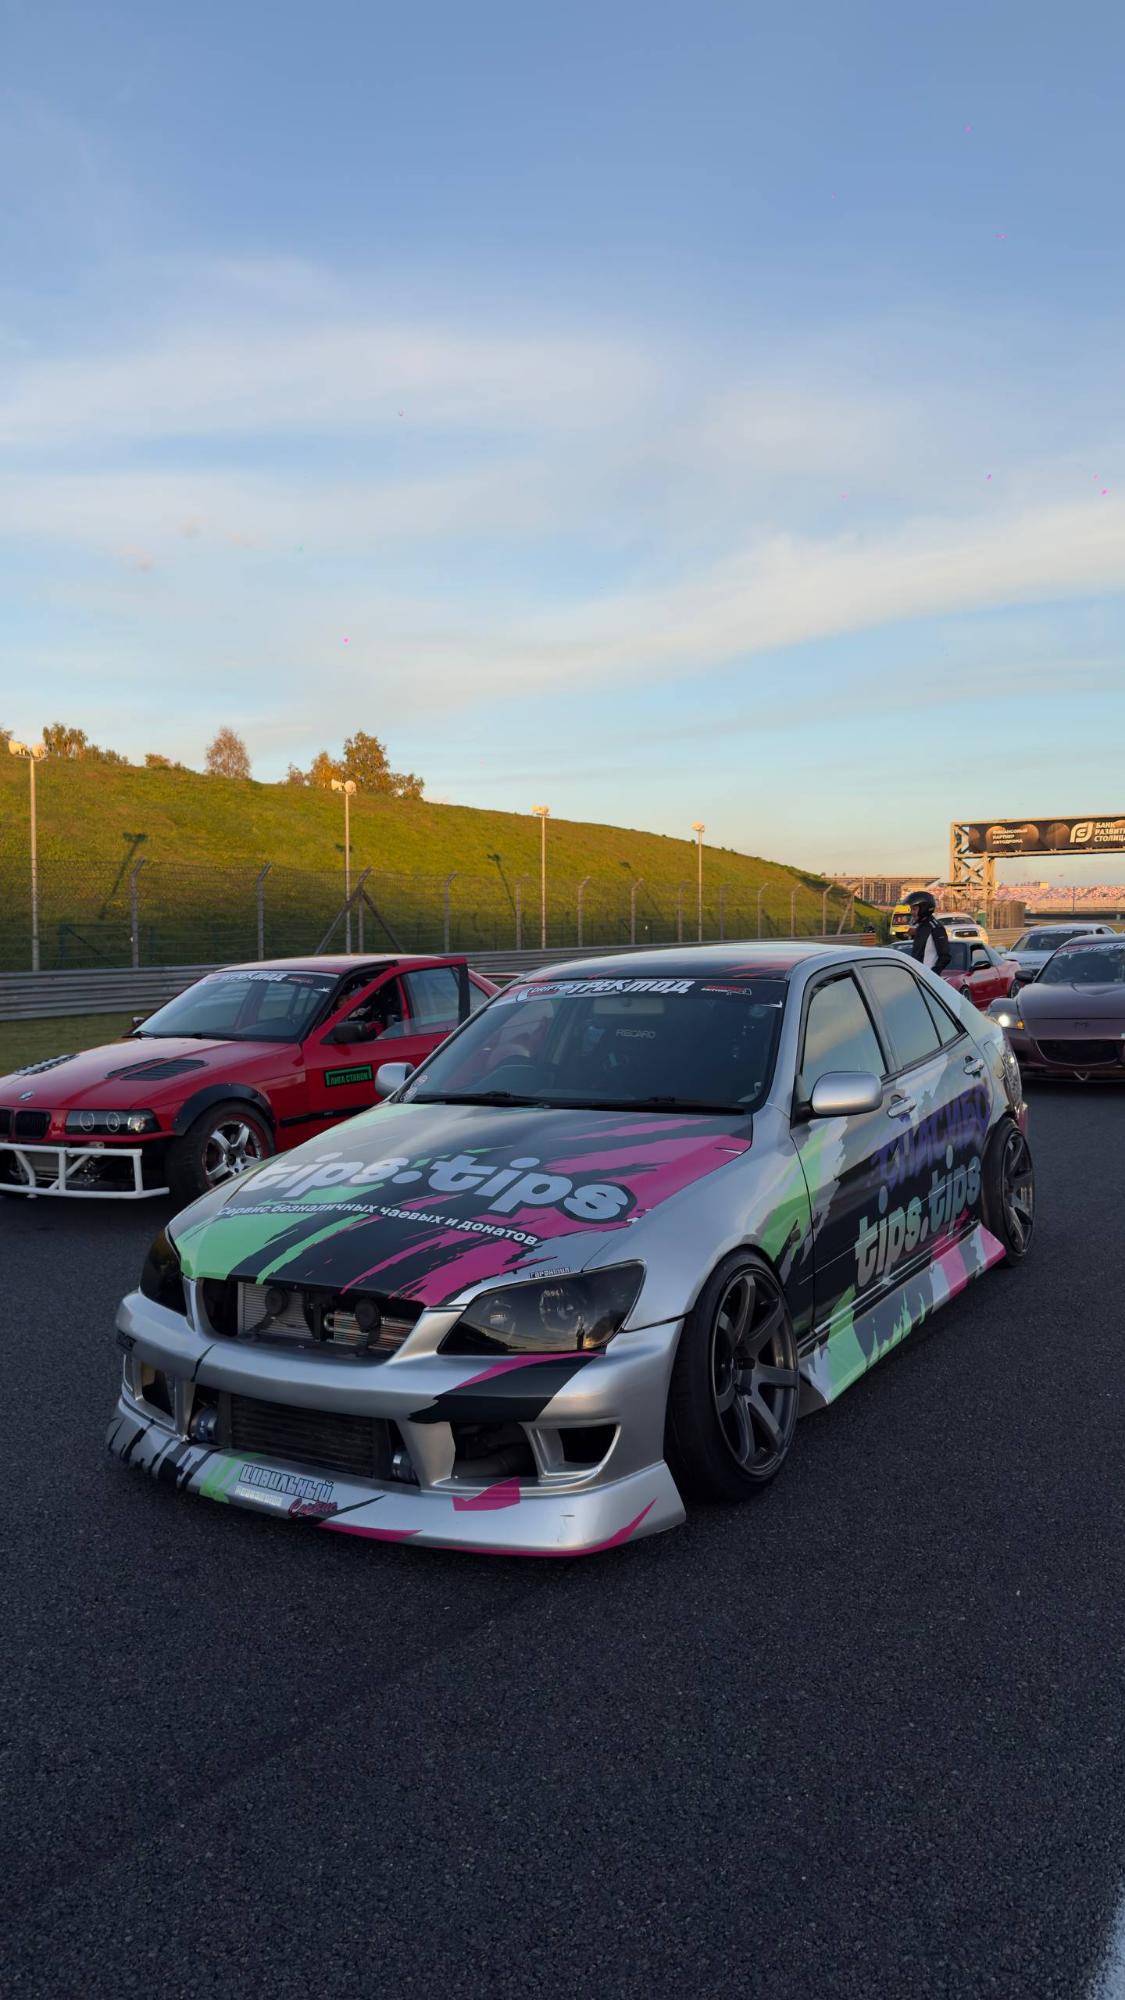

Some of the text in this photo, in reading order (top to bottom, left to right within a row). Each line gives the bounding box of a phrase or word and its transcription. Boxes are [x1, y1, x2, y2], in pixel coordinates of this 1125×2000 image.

[217, 1203, 538, 1246] Сервис безналичных чаевых и донатов
